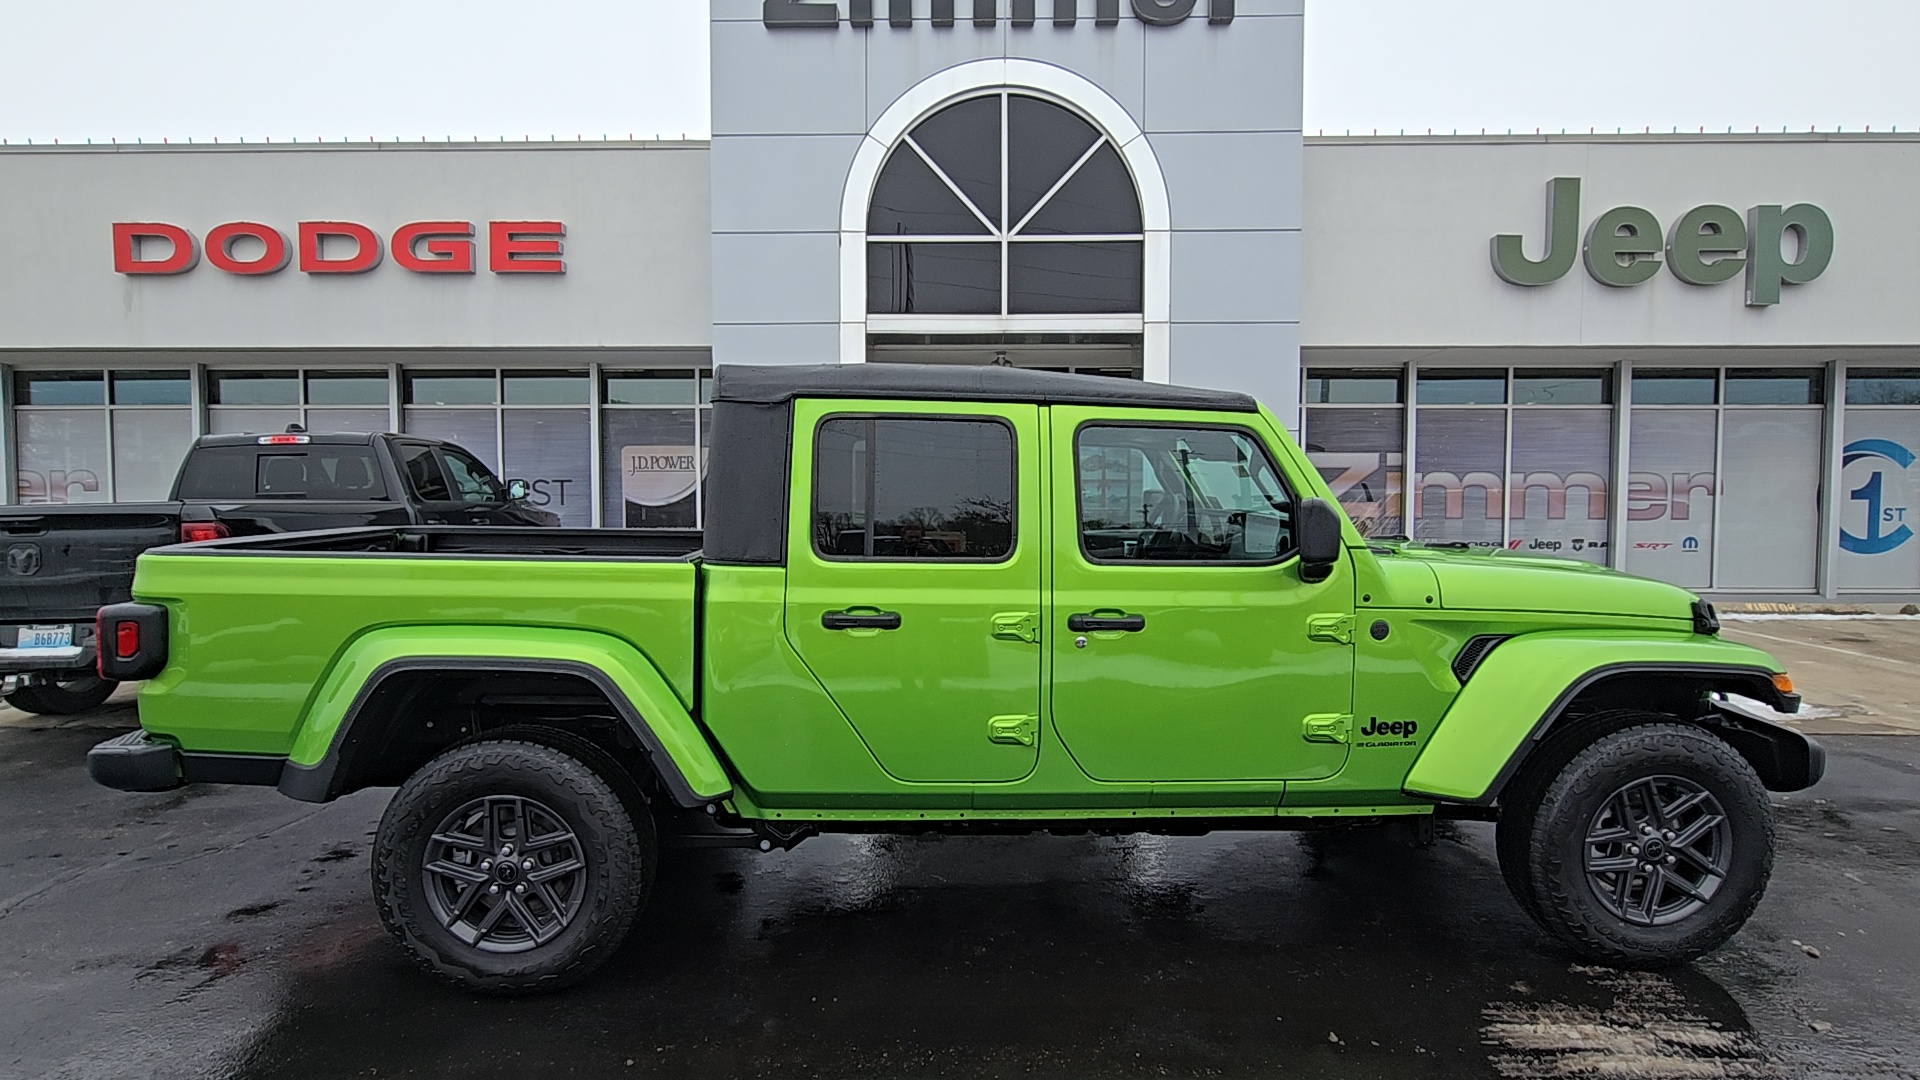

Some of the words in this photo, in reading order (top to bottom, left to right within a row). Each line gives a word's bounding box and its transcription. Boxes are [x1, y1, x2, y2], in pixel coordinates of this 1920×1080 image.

[112, 221, 567, 276] DODGE
[1490, 177, 1834, 306] Jeep
[1528, 538, 1562, 551] Jeep
[1745, 603, 1797, 612] VISITOR
[34, 632, 70, 646] B6B773
[1361, 716, 1417, 738] Jeep
